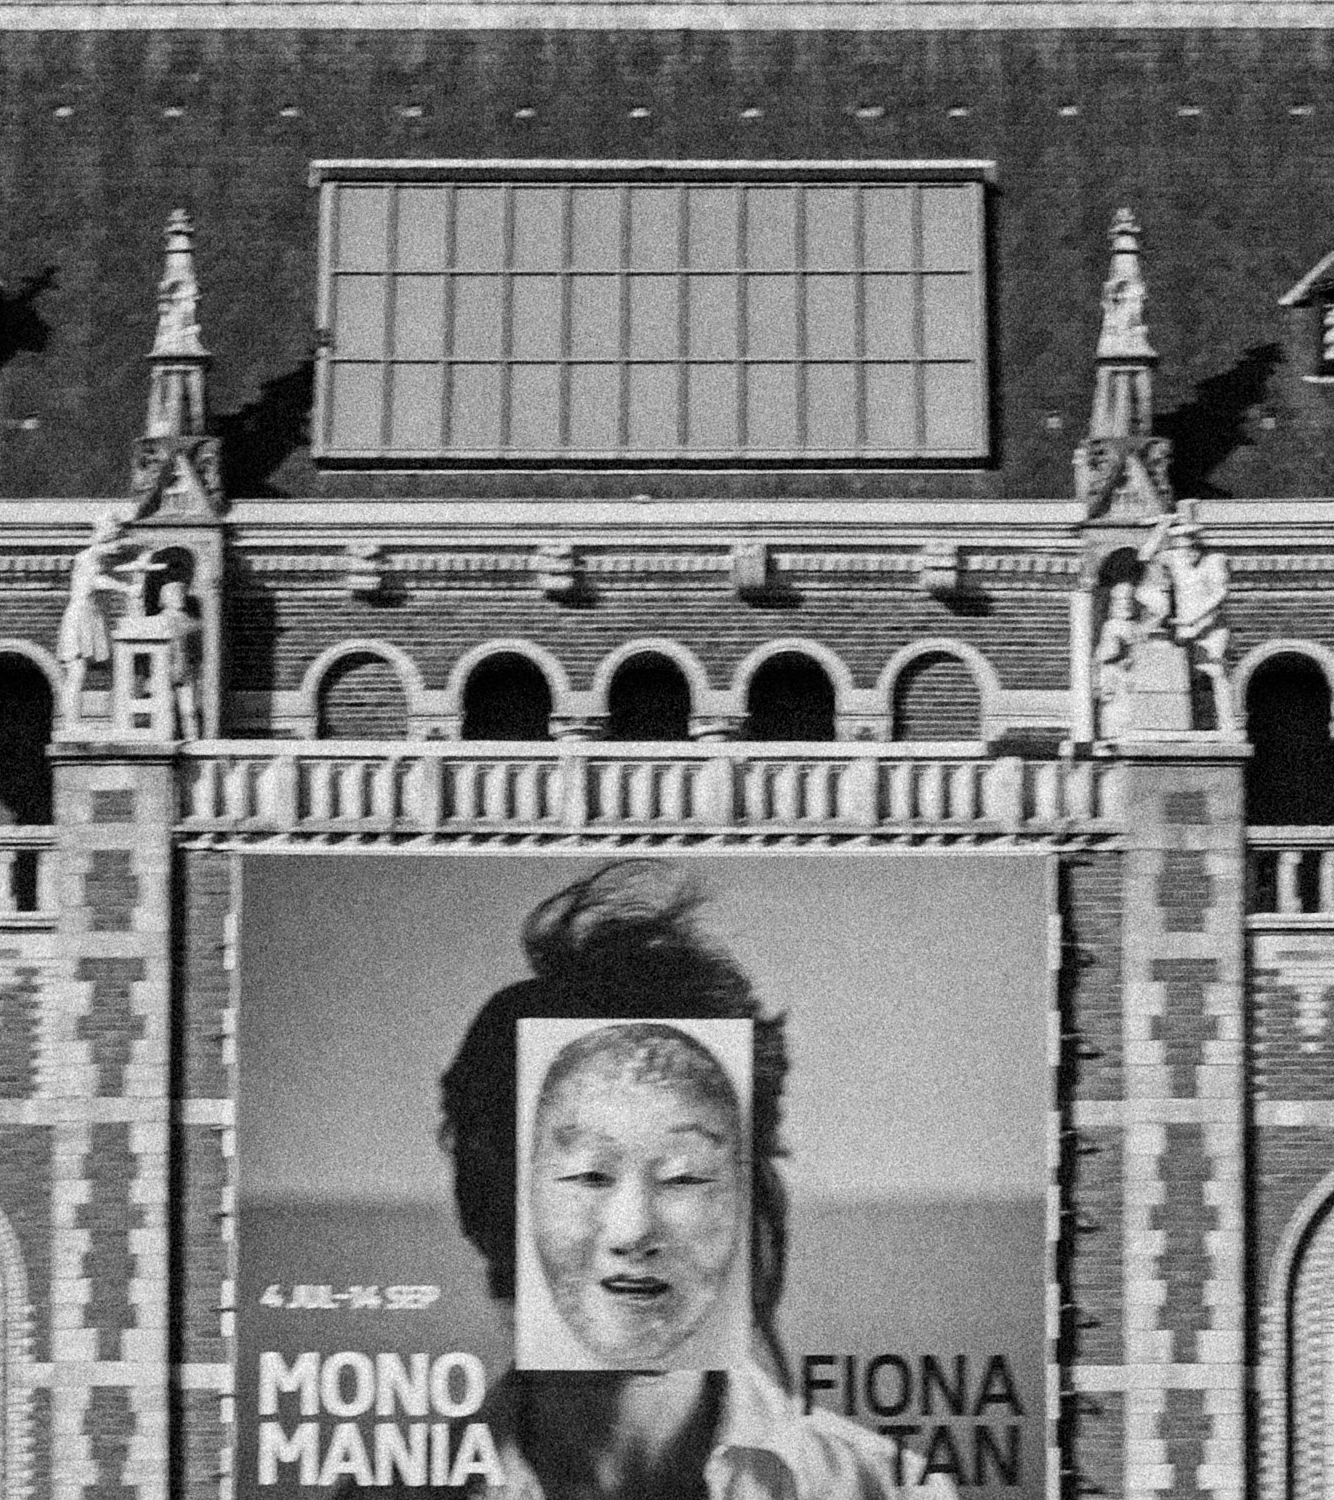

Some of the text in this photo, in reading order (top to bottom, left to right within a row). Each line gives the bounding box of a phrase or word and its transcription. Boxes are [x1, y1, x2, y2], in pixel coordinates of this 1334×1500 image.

[258, 1351, 486, 1417] MONO
[802, 1354, 1025, 1417] FIONA
[258, 1421, 506, 1487] MANIA
[877, 1424, 1020, 1487] TAN
